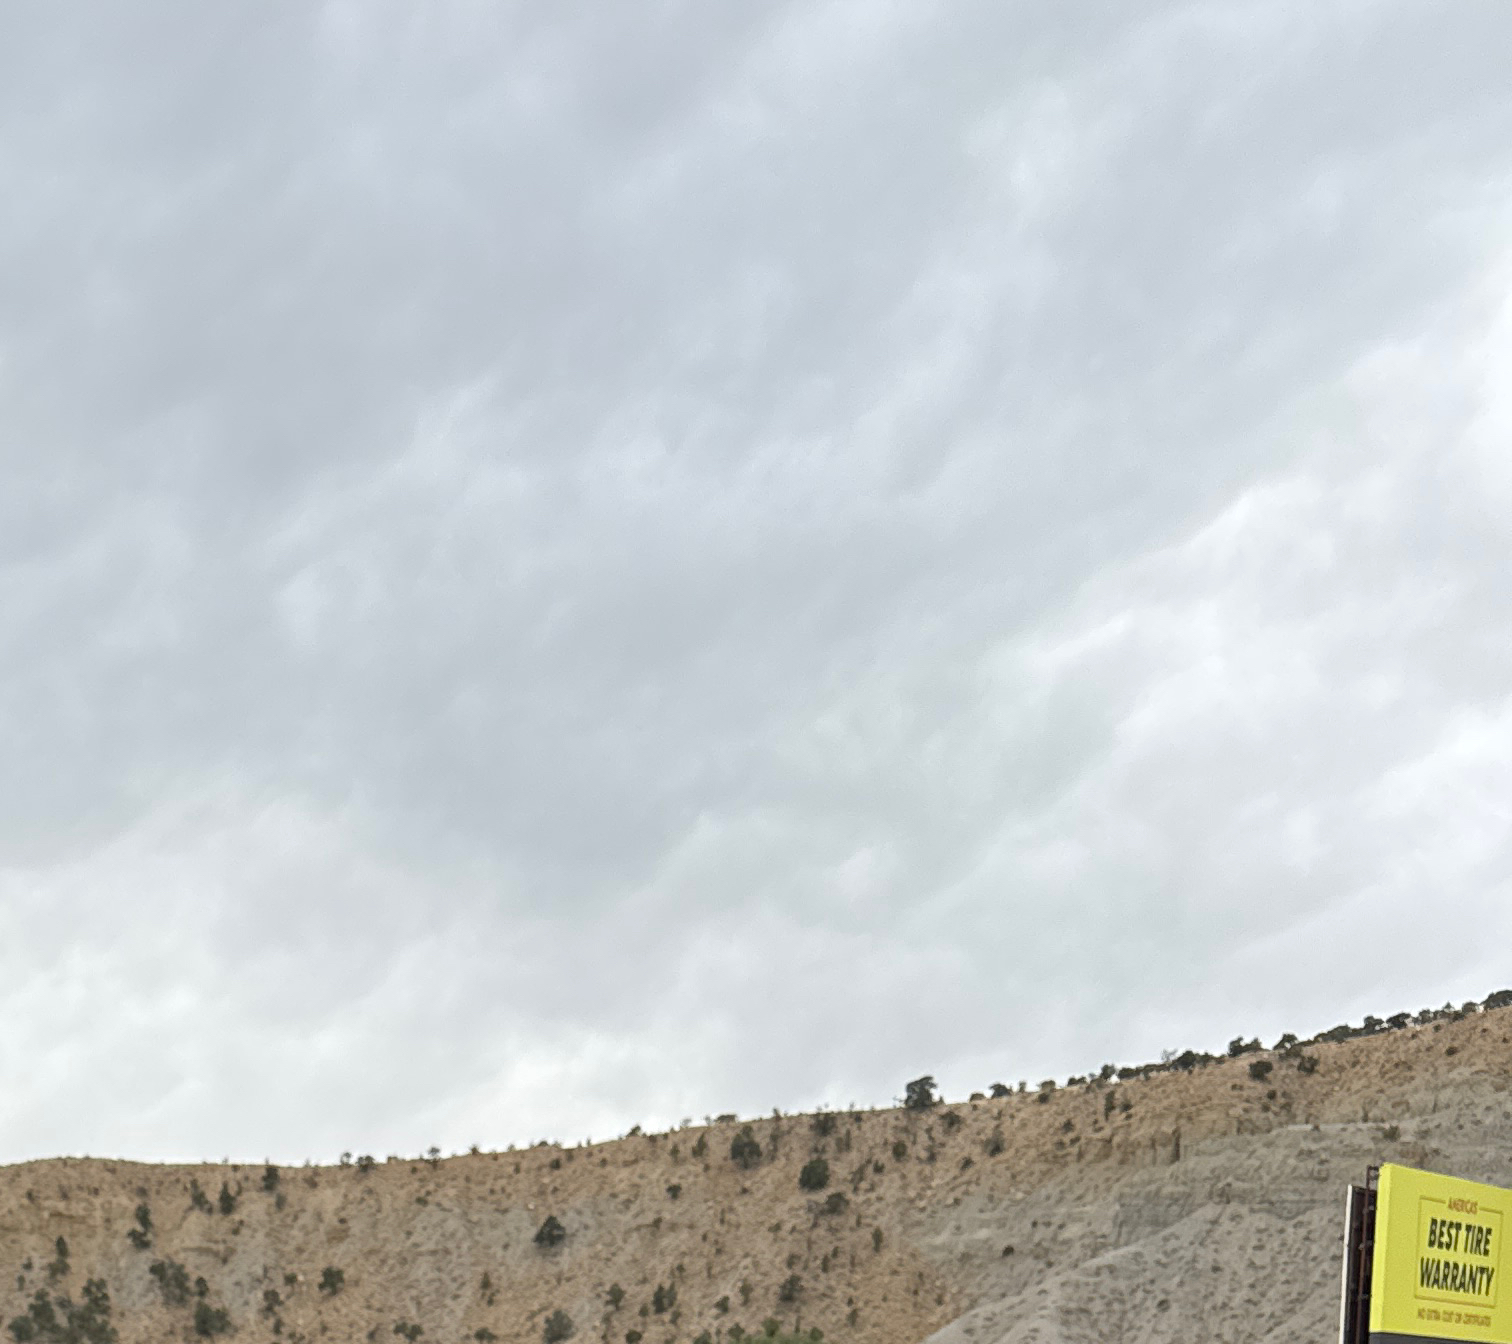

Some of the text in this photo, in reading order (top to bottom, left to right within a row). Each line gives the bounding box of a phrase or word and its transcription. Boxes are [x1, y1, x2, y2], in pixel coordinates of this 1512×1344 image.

[1427, 1216, 1493, 1257] BEST TIRE
[1419, 1255, 1495, 1297] WARRANTY
